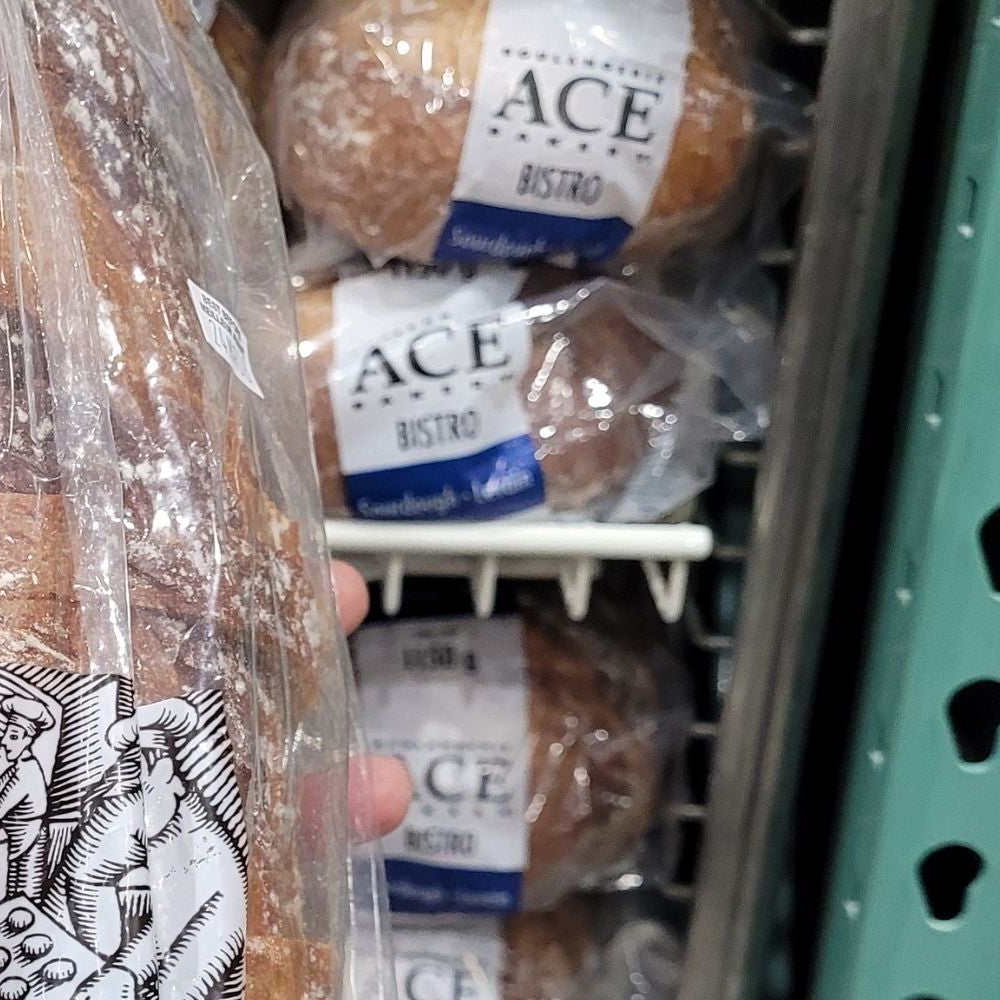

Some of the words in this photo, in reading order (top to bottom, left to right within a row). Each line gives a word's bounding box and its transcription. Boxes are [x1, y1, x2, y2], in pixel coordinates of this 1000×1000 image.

[490, 69, 662, 144] ACE
[516, 162, 603, 205] BISTRO
[353, 318, 513, 393] ACE
[395, 411, 482, 451] BISTRO
